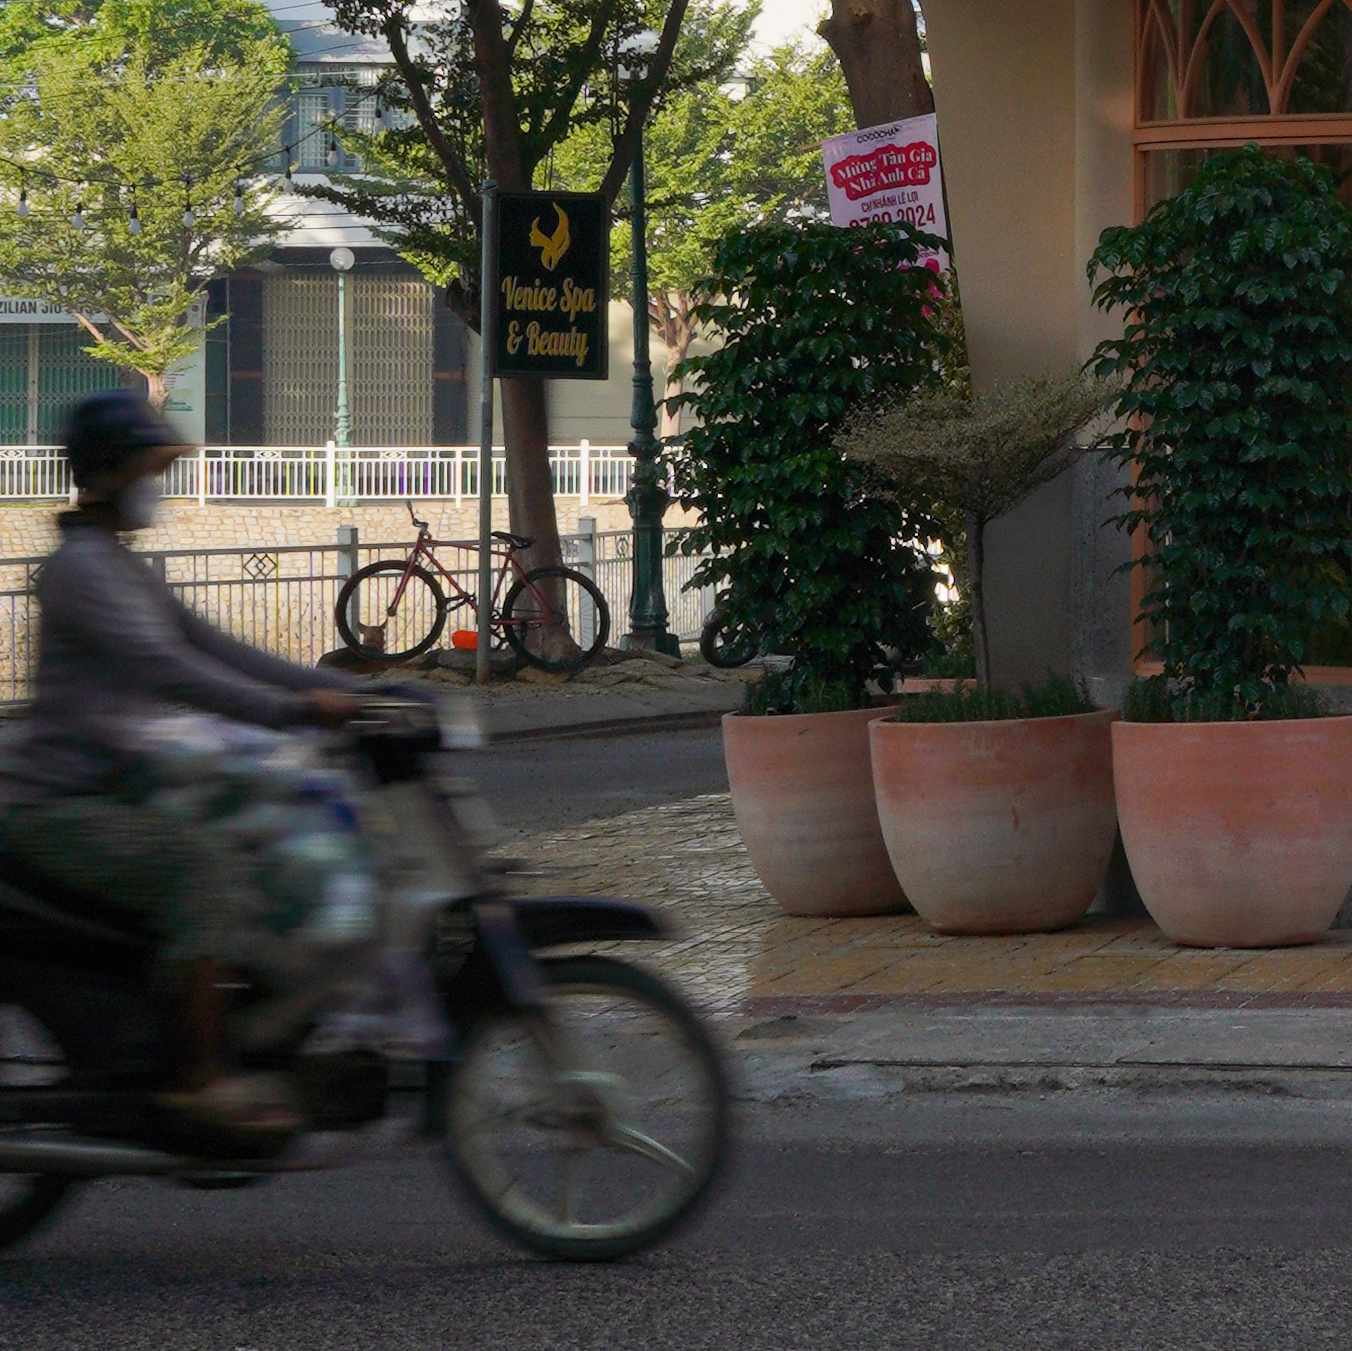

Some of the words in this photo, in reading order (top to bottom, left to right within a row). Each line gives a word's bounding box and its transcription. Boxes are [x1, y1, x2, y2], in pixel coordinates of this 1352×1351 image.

[879, 150, 906, 167] Tân
[909, 148, 933, 163] Gia
[849, 173, 876, 195] Nhà
[878, 167, 904, 186] Anh
[501, 276, 558, 312] Venice
[560, 277, 596, 322] Spa
[507, 320, 523, 355] &
[526, 320, 589, 367] Beauty
